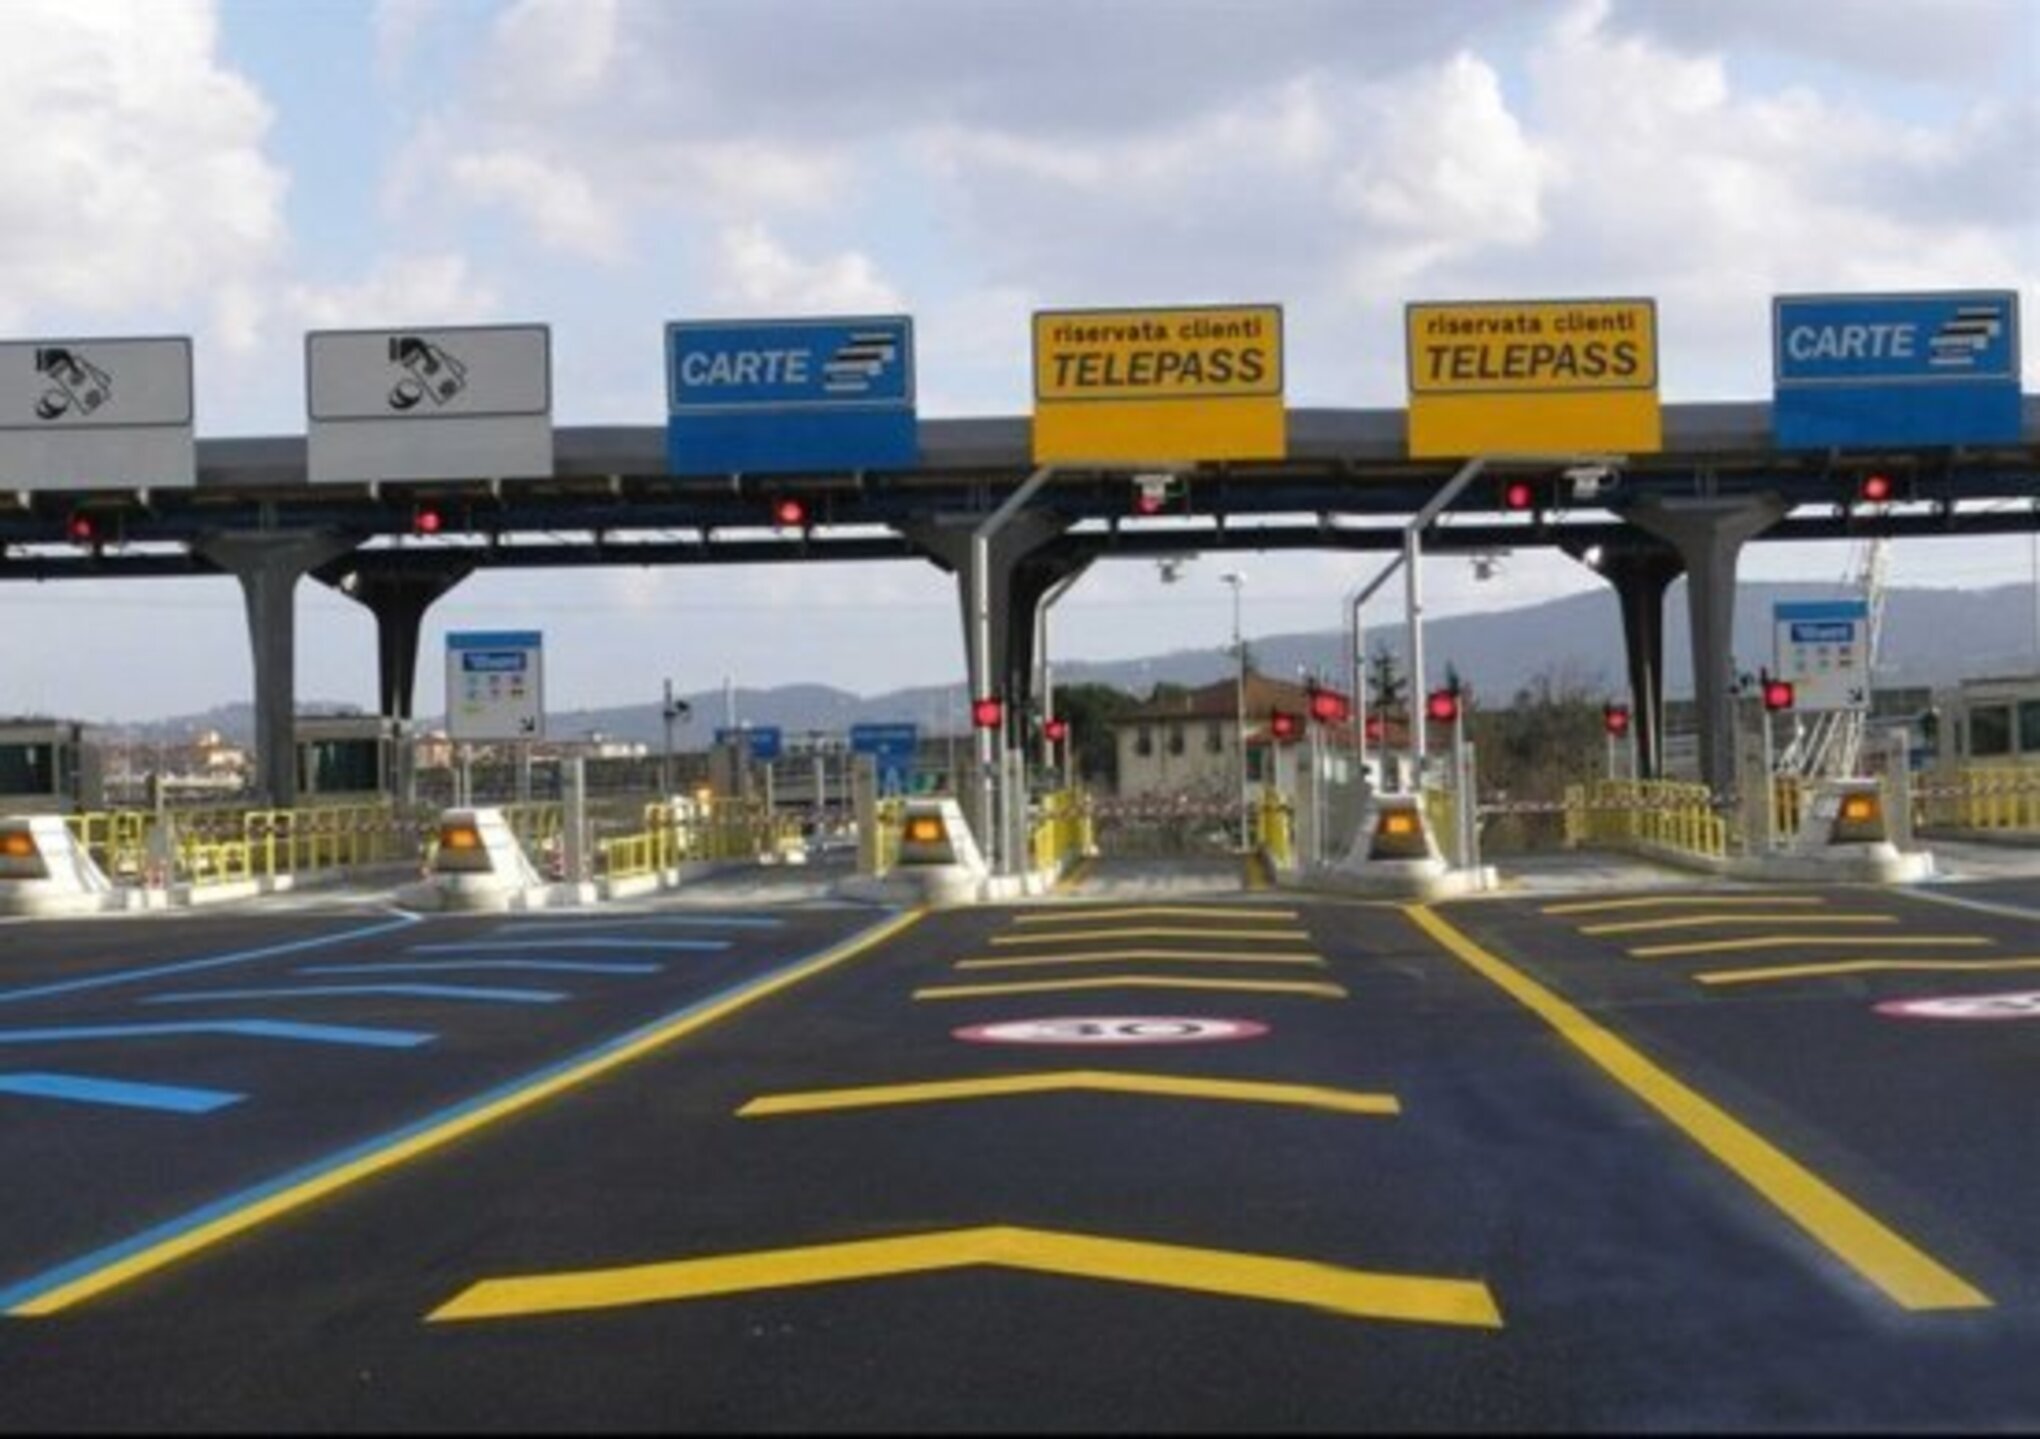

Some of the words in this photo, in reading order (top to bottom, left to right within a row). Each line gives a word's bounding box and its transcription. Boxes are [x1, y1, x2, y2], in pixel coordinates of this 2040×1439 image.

[1053, 321, 1166, 343] riservata
[1178, 317, 1263, 340] clienti
[1427, 313, 1541, 336] riservata
[1552, 310, 1635, 332] clienti
[1426, 340, 1638, 380] TELEPASS
[1787, 324, 1917, 361] CARTE
[680, 350, 811, 386] CARTE
[1052, 347, 1265, 387] TELEPASS
